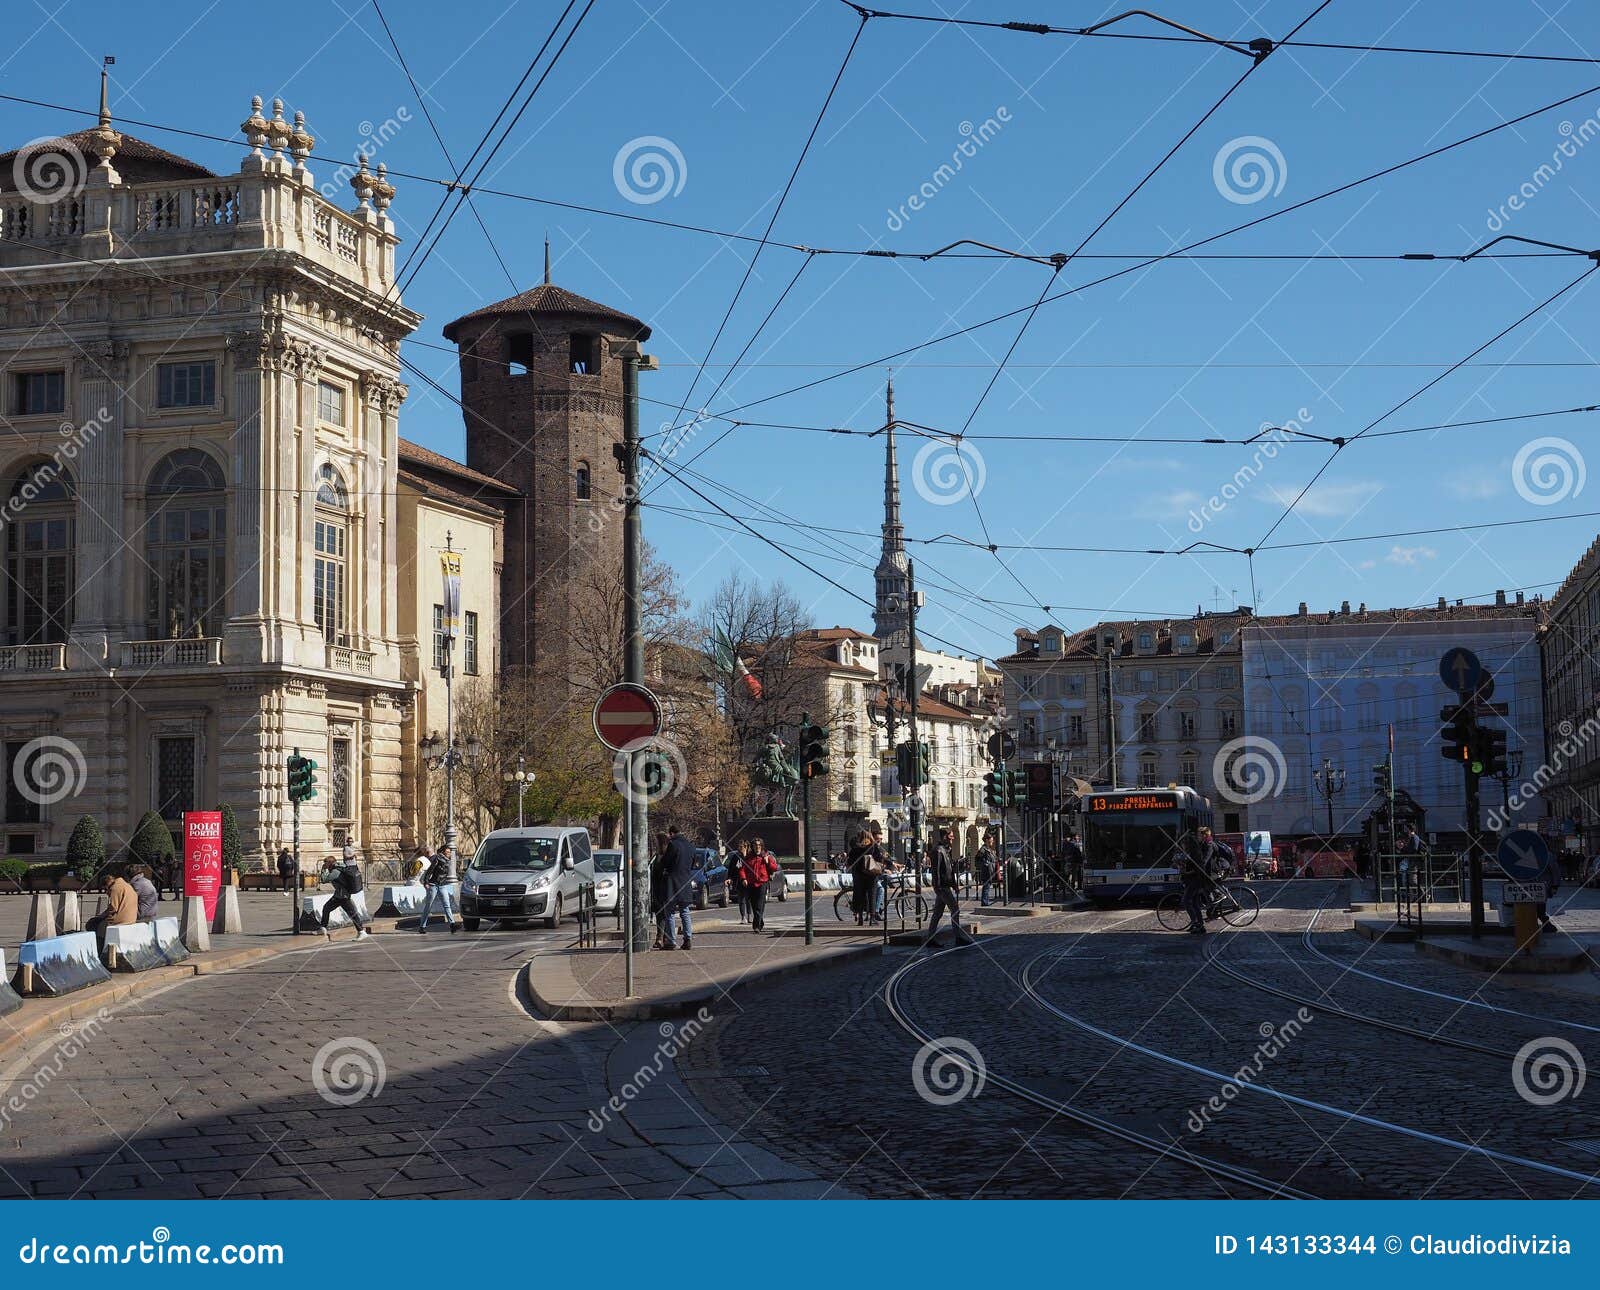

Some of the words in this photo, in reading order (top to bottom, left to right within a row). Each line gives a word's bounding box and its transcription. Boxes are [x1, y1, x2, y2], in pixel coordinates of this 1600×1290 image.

[1094, 798, 1106, 810] 13
[1124, 796, 1156, 804] PARELLA
[189, 822, 220, 830] DOLCI
